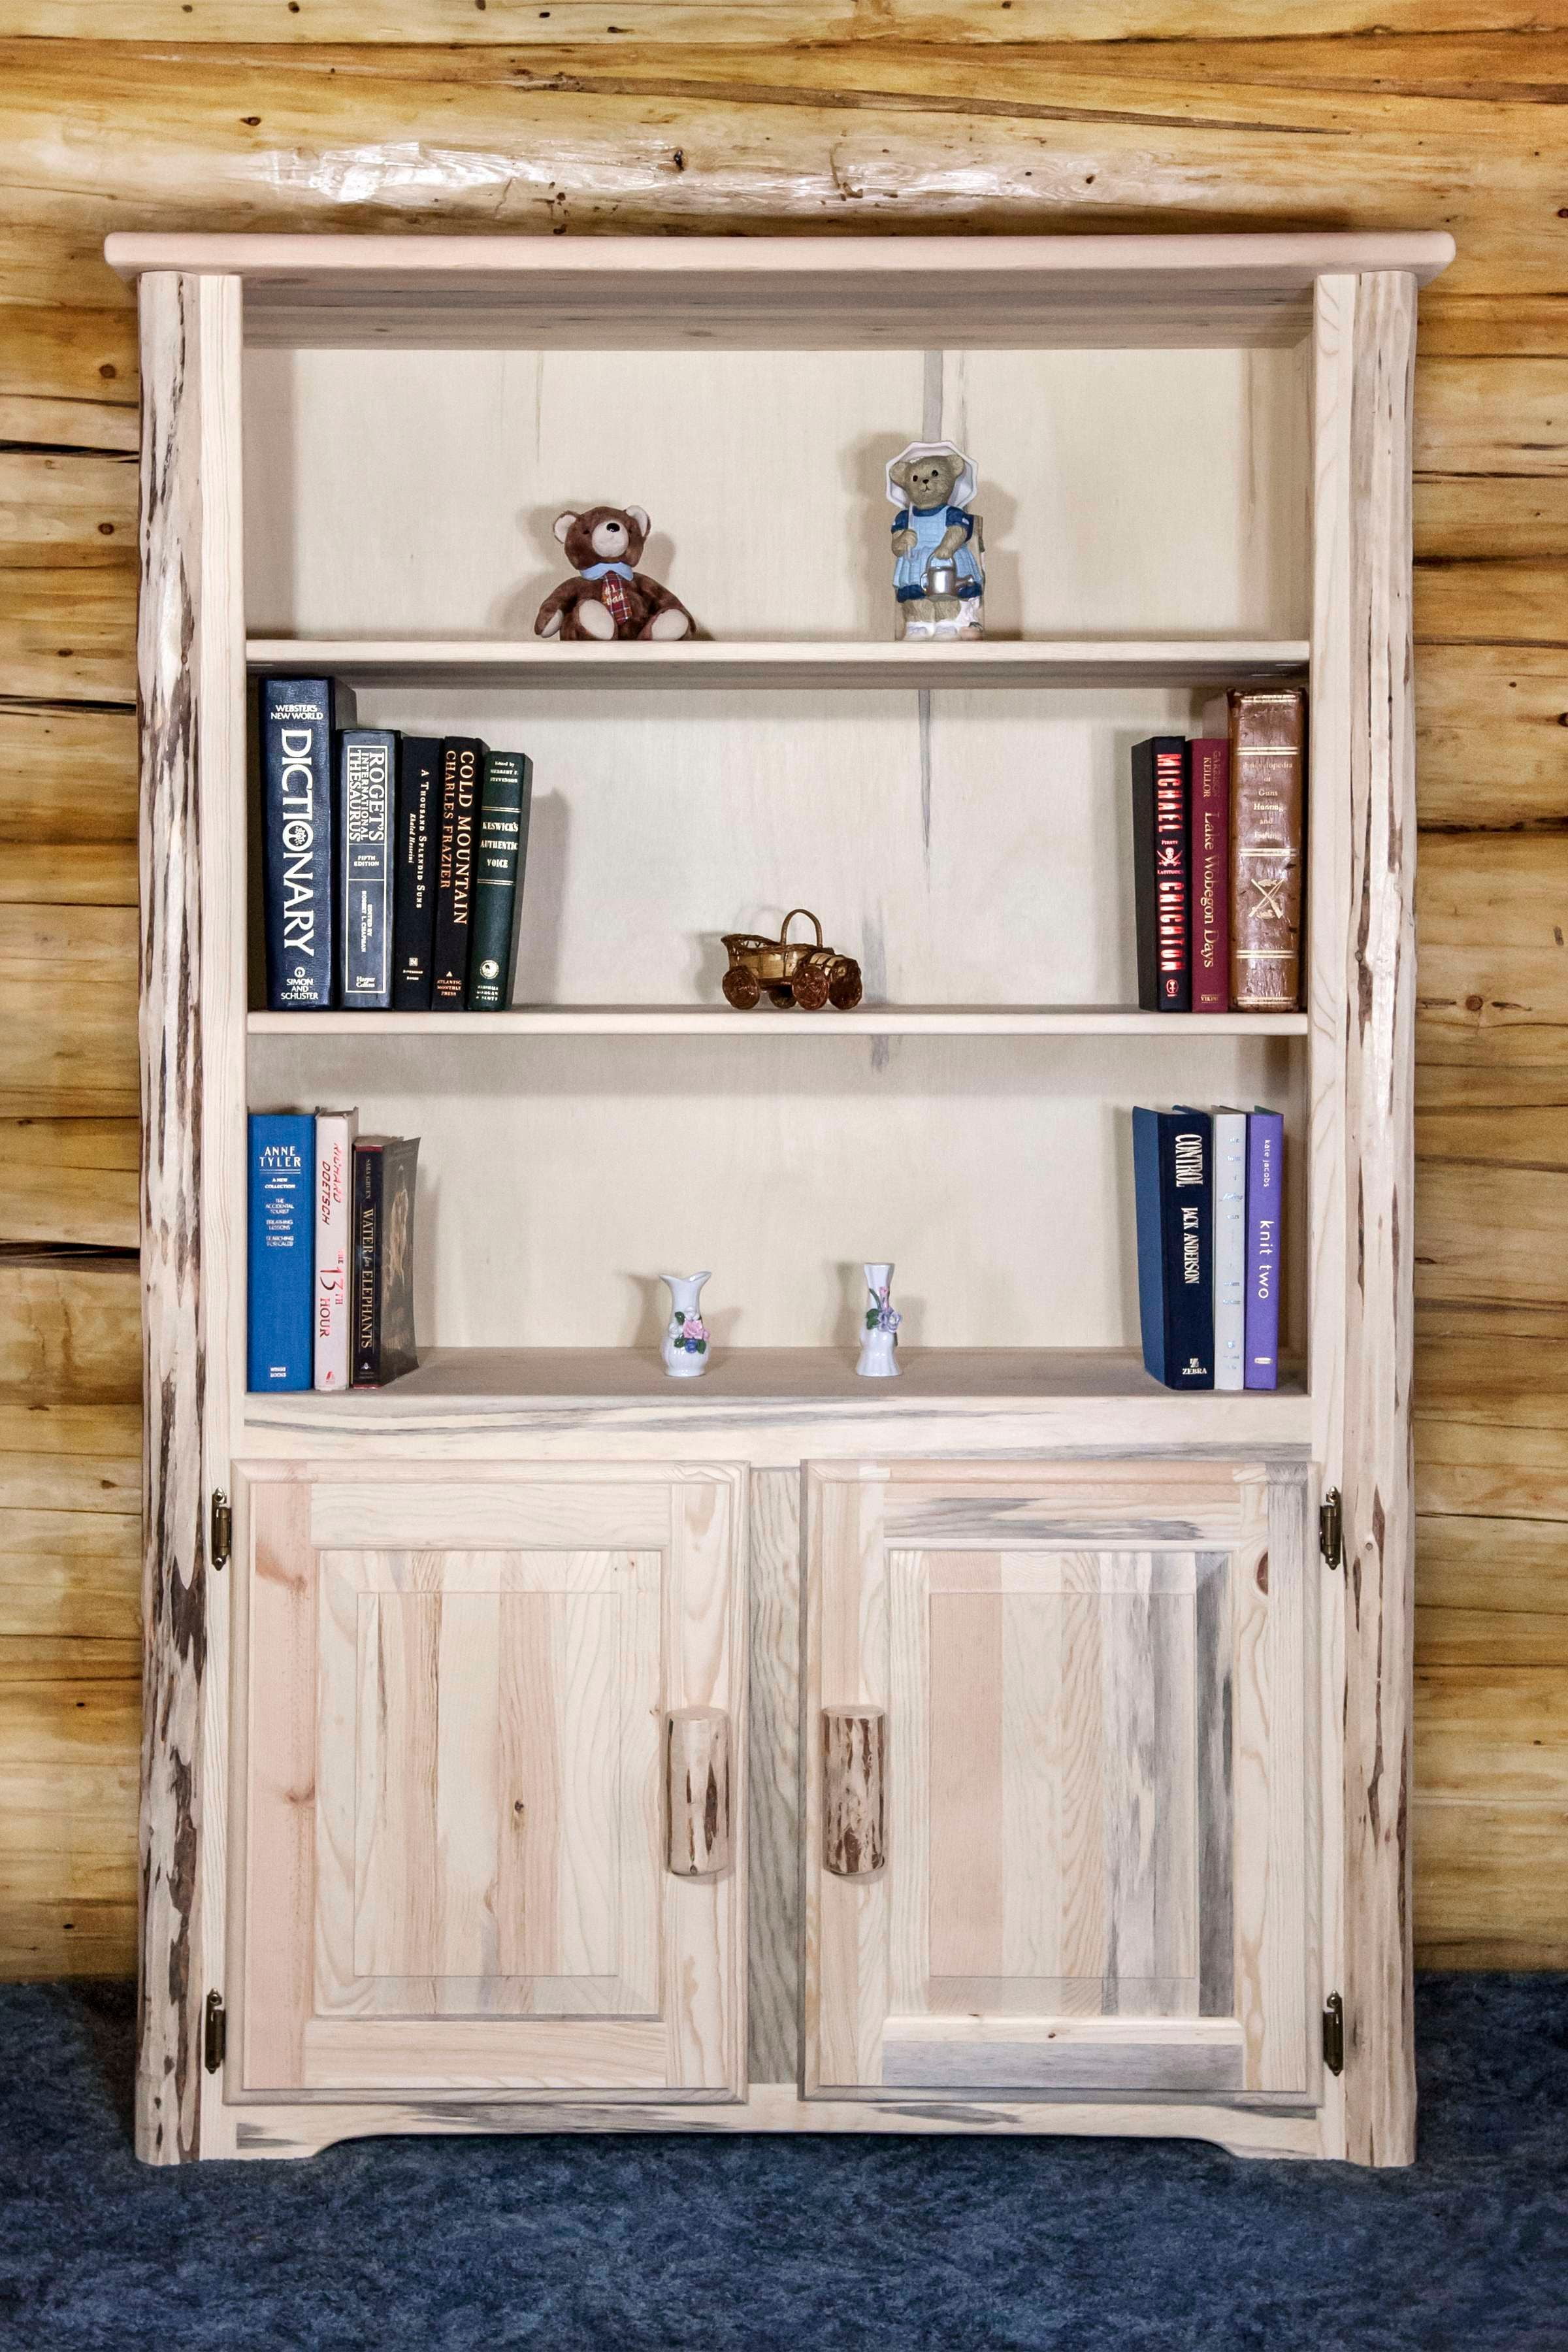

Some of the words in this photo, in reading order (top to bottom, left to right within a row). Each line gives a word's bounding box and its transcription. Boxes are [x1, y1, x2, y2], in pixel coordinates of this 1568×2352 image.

[350, 749, 361, 842] THESAURUS
[361, 753, 370, 841] INTERNATIONAL
[368, 751, 385, 841] ROGET'S
[444, 751, 457, 819] CHARLES
[459, 751, 475, 808] COLD
[1157, 753, 1183, 833] MICHAEL
[1203, 757, 1211, 798] KEILLOR
[282, 728, 314, 957] DICTIONARY
[480, 840, 518, 851] AUTHENTIC
[482, 821, 519, 832] KESWICK'S
[1204, 812, 1220, 850] Lake
[440, 825, 453, 889] FRAZIER
[453, 815, 472, 924] MOUNTAIN
[487, 858, 508, 868] VOICE
[1200, 854, 1219, 924] Wobegon
[1159, 881, 1185, 972] CRICHTON
[1200, 929, 1219, 968] Days
[259, 1156, 301, 1167] TYLER
[265, 1146, 296, 1156] ANNE
[333, 1142, 342, 1203] RICHARD
[1175, 1134, 1203, 1188] CONTROL
[1262, 1160, 1271, 1188] jacobs
[322, 1160, 331, 1226] DOETSCH
[1181, 1207, 1199, 1230] JACK
[362, 1208, 374, 1254] WATER
[1260, 1220, 1275, 1255] knit
[1183, 1232, 1200, 1284] ANDERSON
[1258, 1264, 1273, 1299] two
[319, 1298, 331, 1338] HOUR
[361, 1270, 374, 1349] ELEPHANTS
